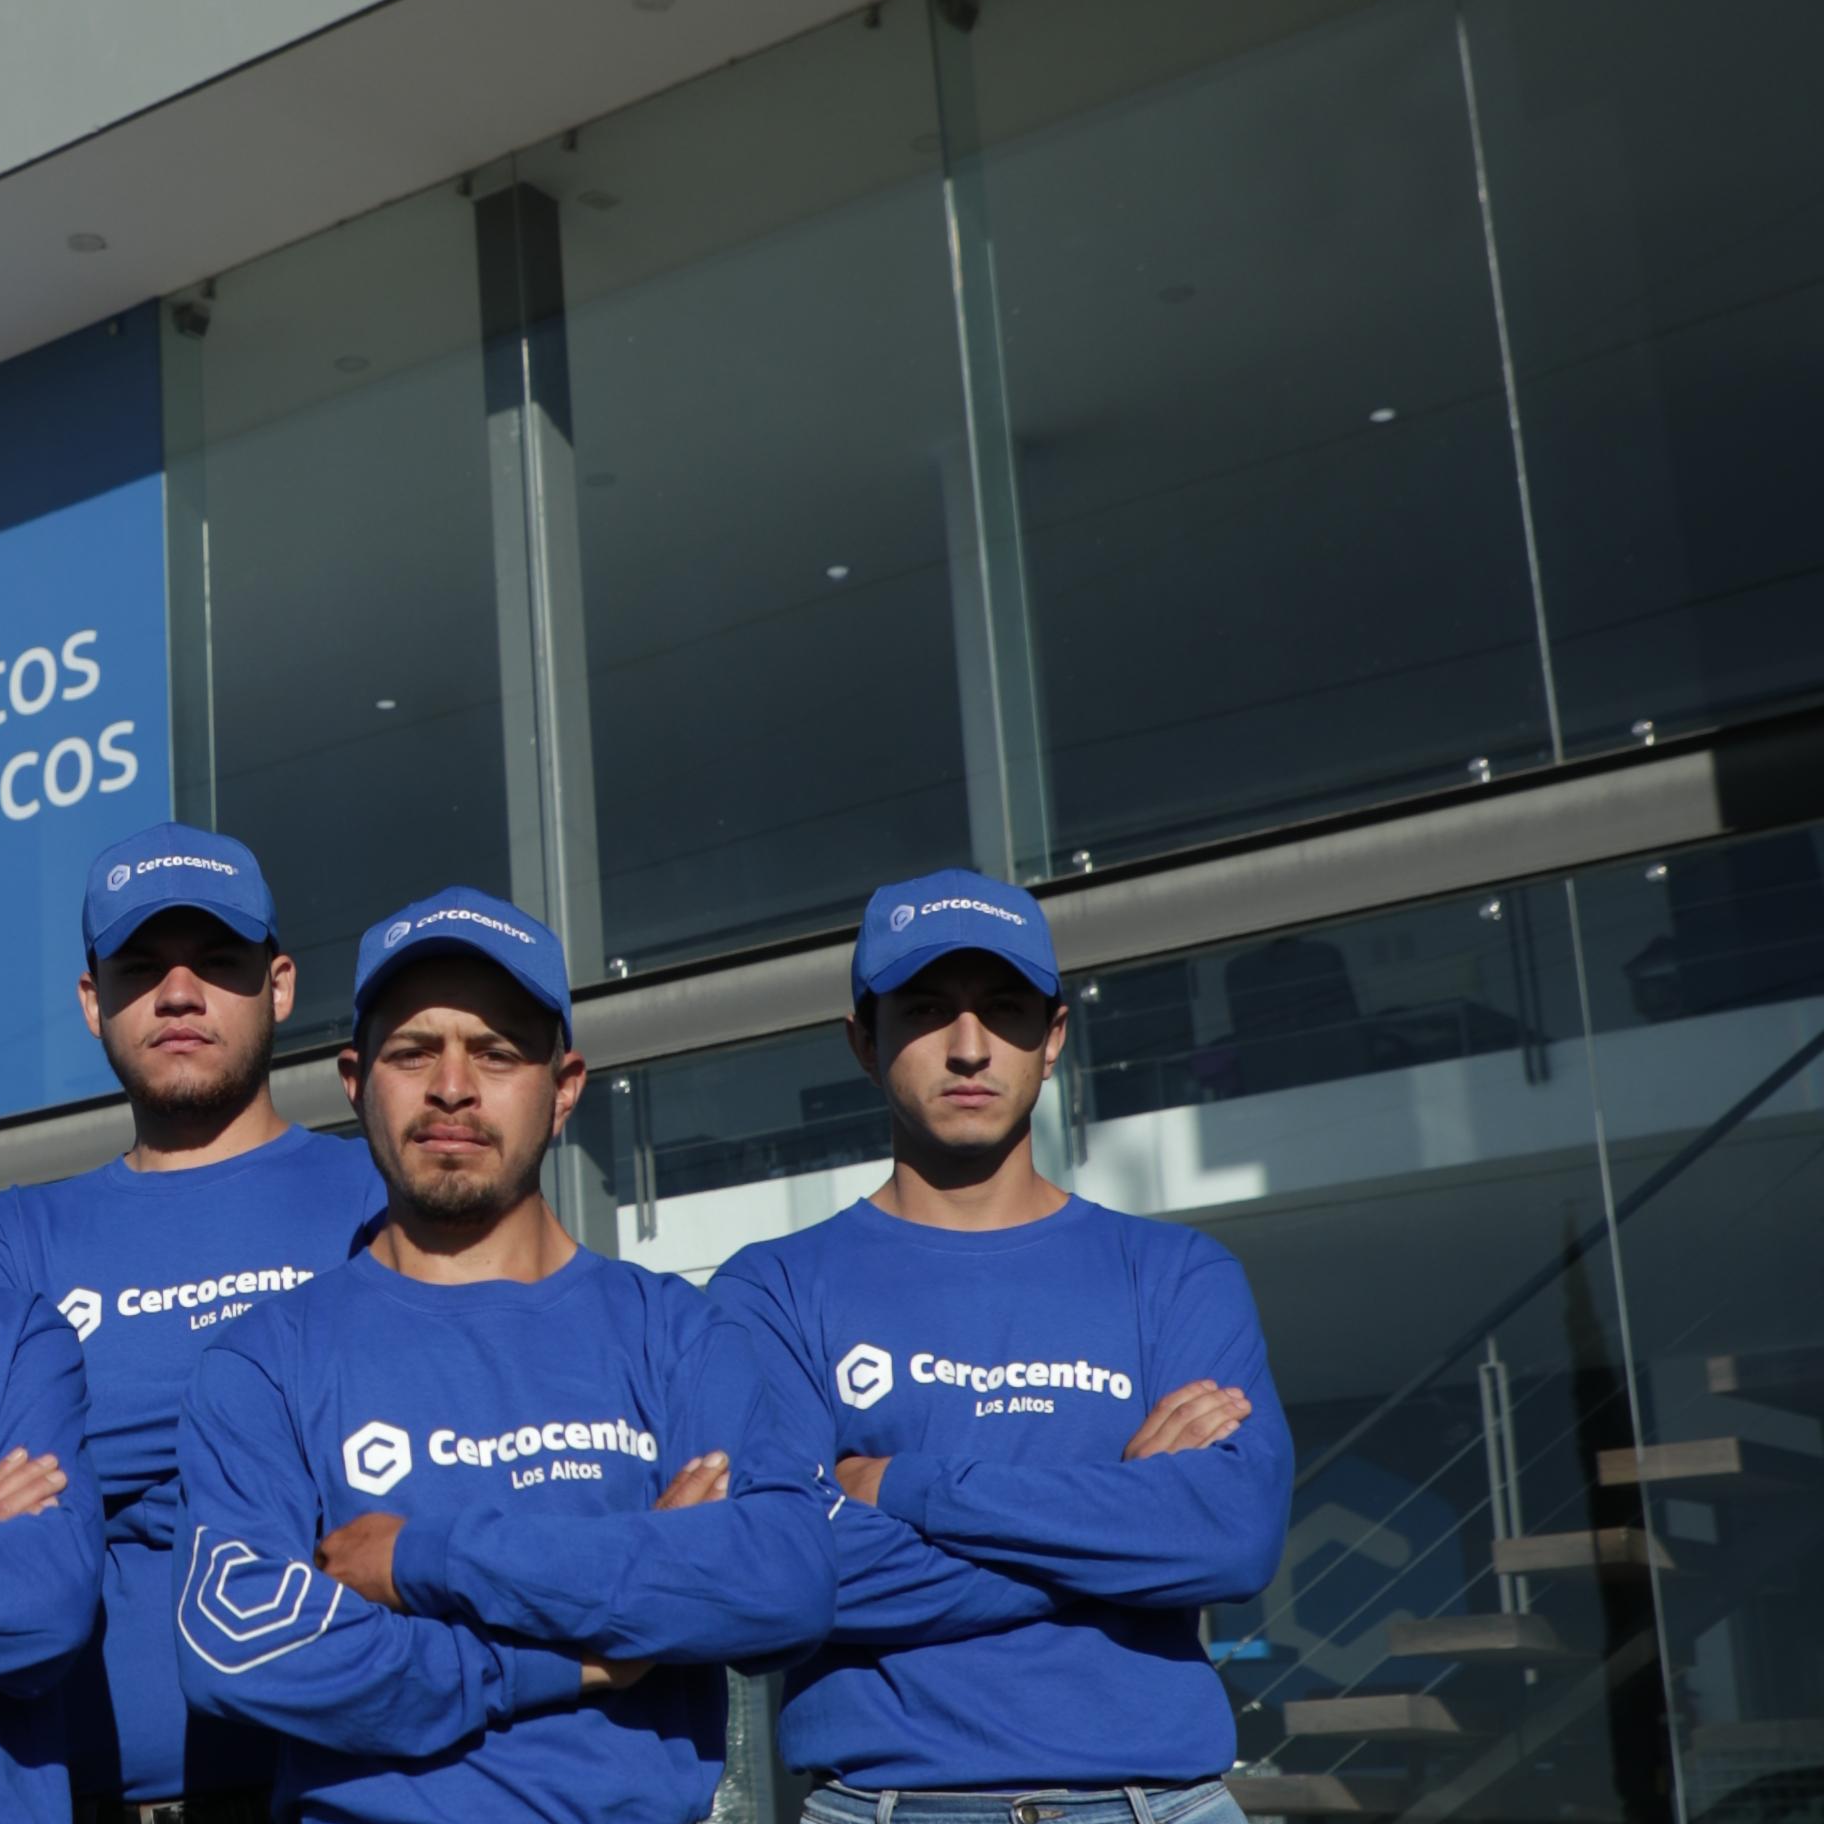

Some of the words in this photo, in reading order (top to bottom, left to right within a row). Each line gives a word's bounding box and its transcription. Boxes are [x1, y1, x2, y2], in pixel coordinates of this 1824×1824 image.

[117, 1266, 314, 1316] Cercocentr
[190, 1311, 216, 1330] Los
[910, 1353, 1132, 1400] Cercocentro
[976, 1399, 1004, 1417] Los
[1008, 1396, 1054, 1414] Altos
[429, 1419, 658, 1468] Cercocentro
[511, 1466, 545, 1490] Los
[550, 1461, 602, 1480] Altos
